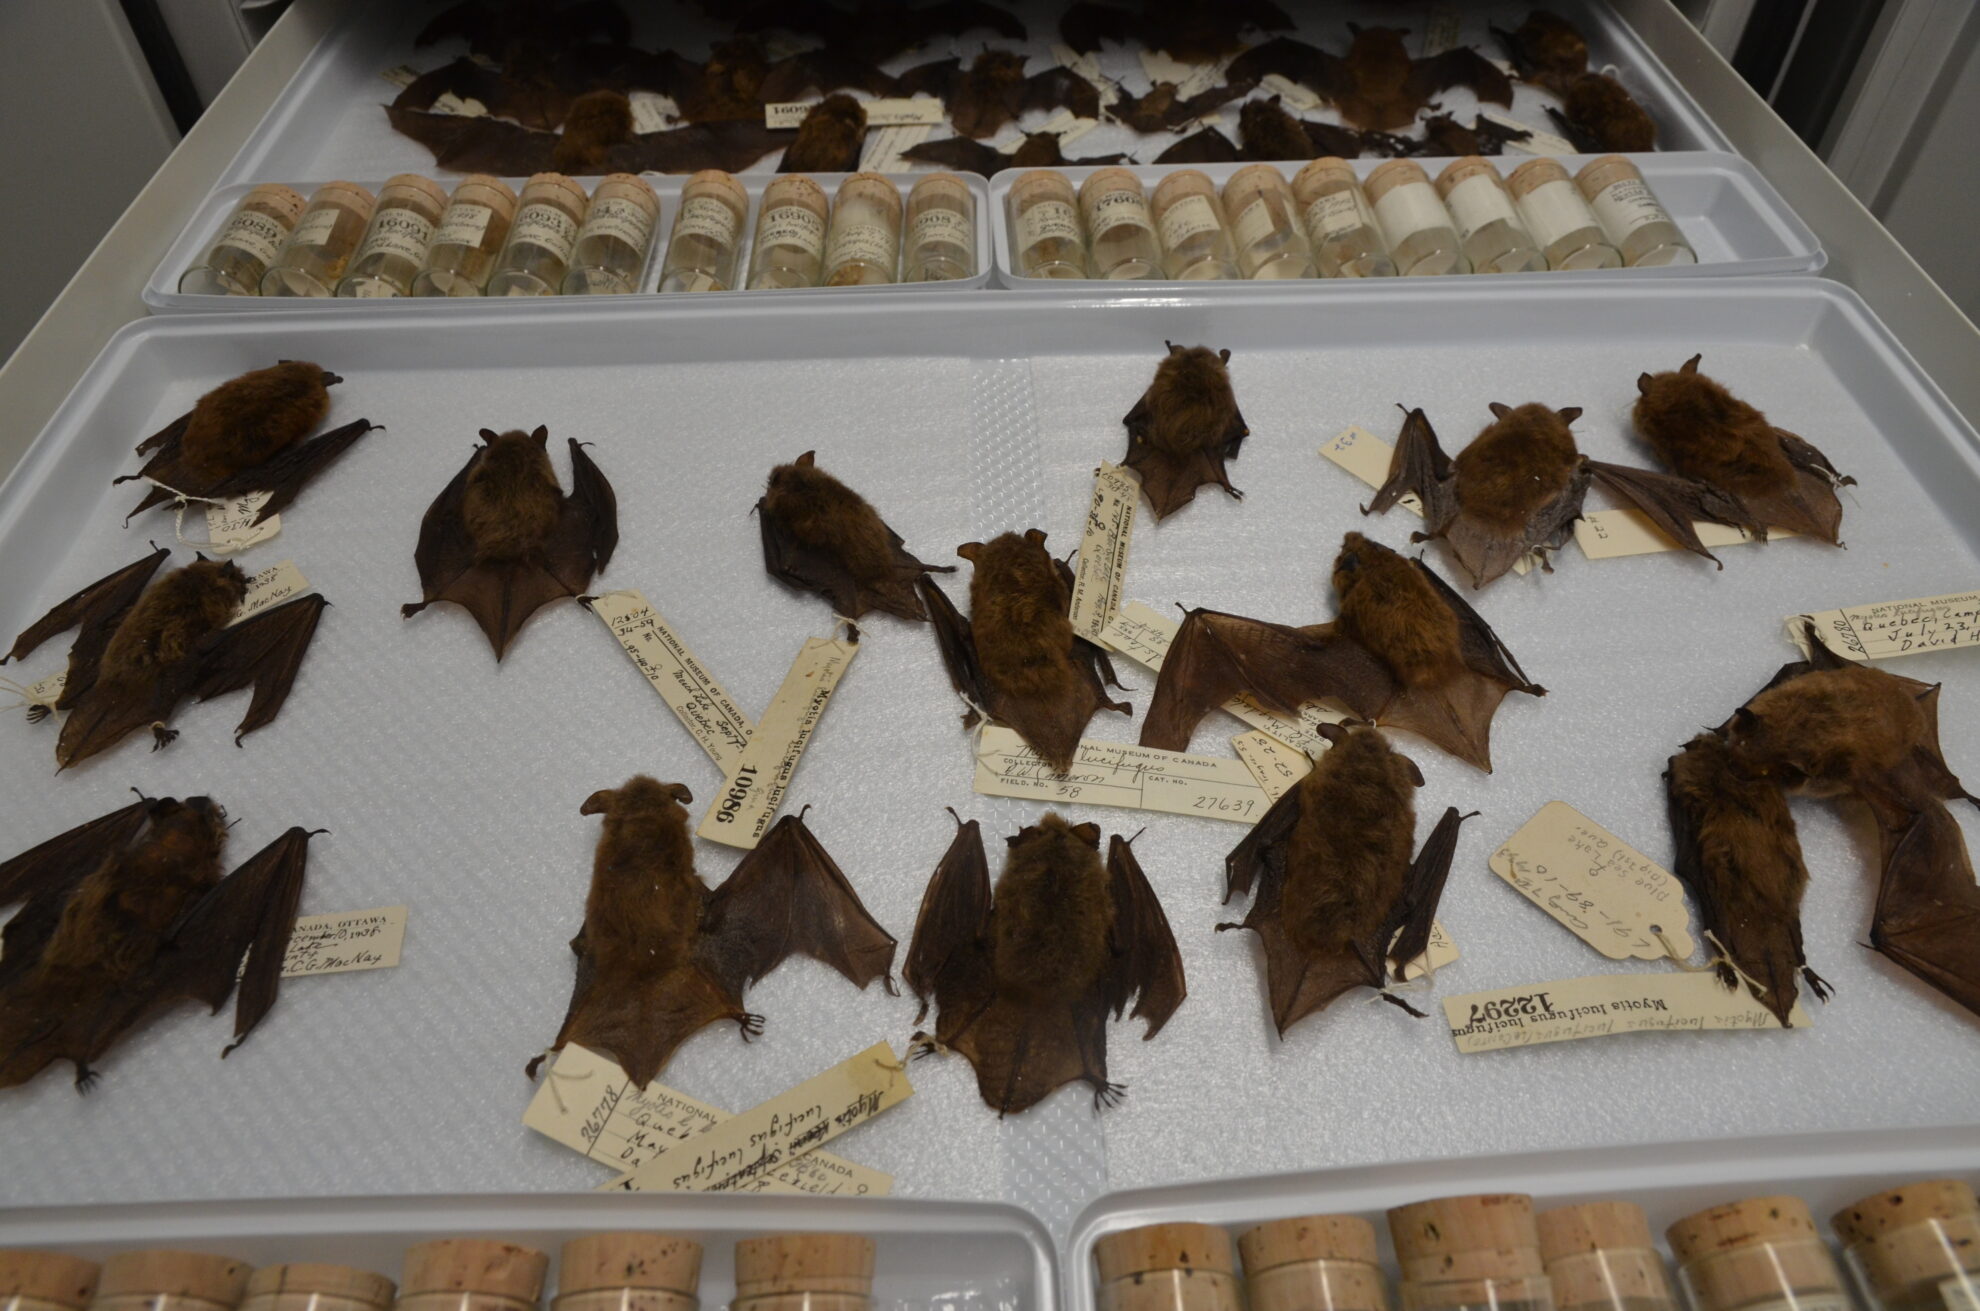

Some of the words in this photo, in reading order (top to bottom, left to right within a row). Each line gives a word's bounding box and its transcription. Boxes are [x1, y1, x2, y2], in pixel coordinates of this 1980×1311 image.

[1120, 504, 1132, 537] NATIONAL
[1116, 542, 1125, 569] MUSEUM
[1114, 571, 1121, 582] OF
[1870, 601, 1923, 614] NATIONAL
[1929, 594, 1978, 605] MUSEUM
[1887, 623, 1936, 644] July
[1900, 631, 1957, 651] David
[656, 625, 685, 656] NATIONAL
[684, 657, 711, 685] MUSEUM
[709, 686, 721, 696] OF
[804, 686, 830, 725] Myotis
[775, 729, 809, 780] lucifugus
[1106, 747, 1150, 759] MUSEUM
[1152, 753, 1168, 761] OF
[1171, 756, 1217, 768] CANADA
[715, 764, 757, 823] 10986
[751, 784, 785, 838] lucifugus
[337, 915, 386, 927] OTTAWA
[1469, 991, 1553, 1023] 12297
[1529, 1003, 1607, 1023] lucifugus
[1610, 997, 1668, 1011] Myotis
[1450, 1017, 1524, 1037] lucifugus
[657, 1092, 717, 1125] NATIONAL
